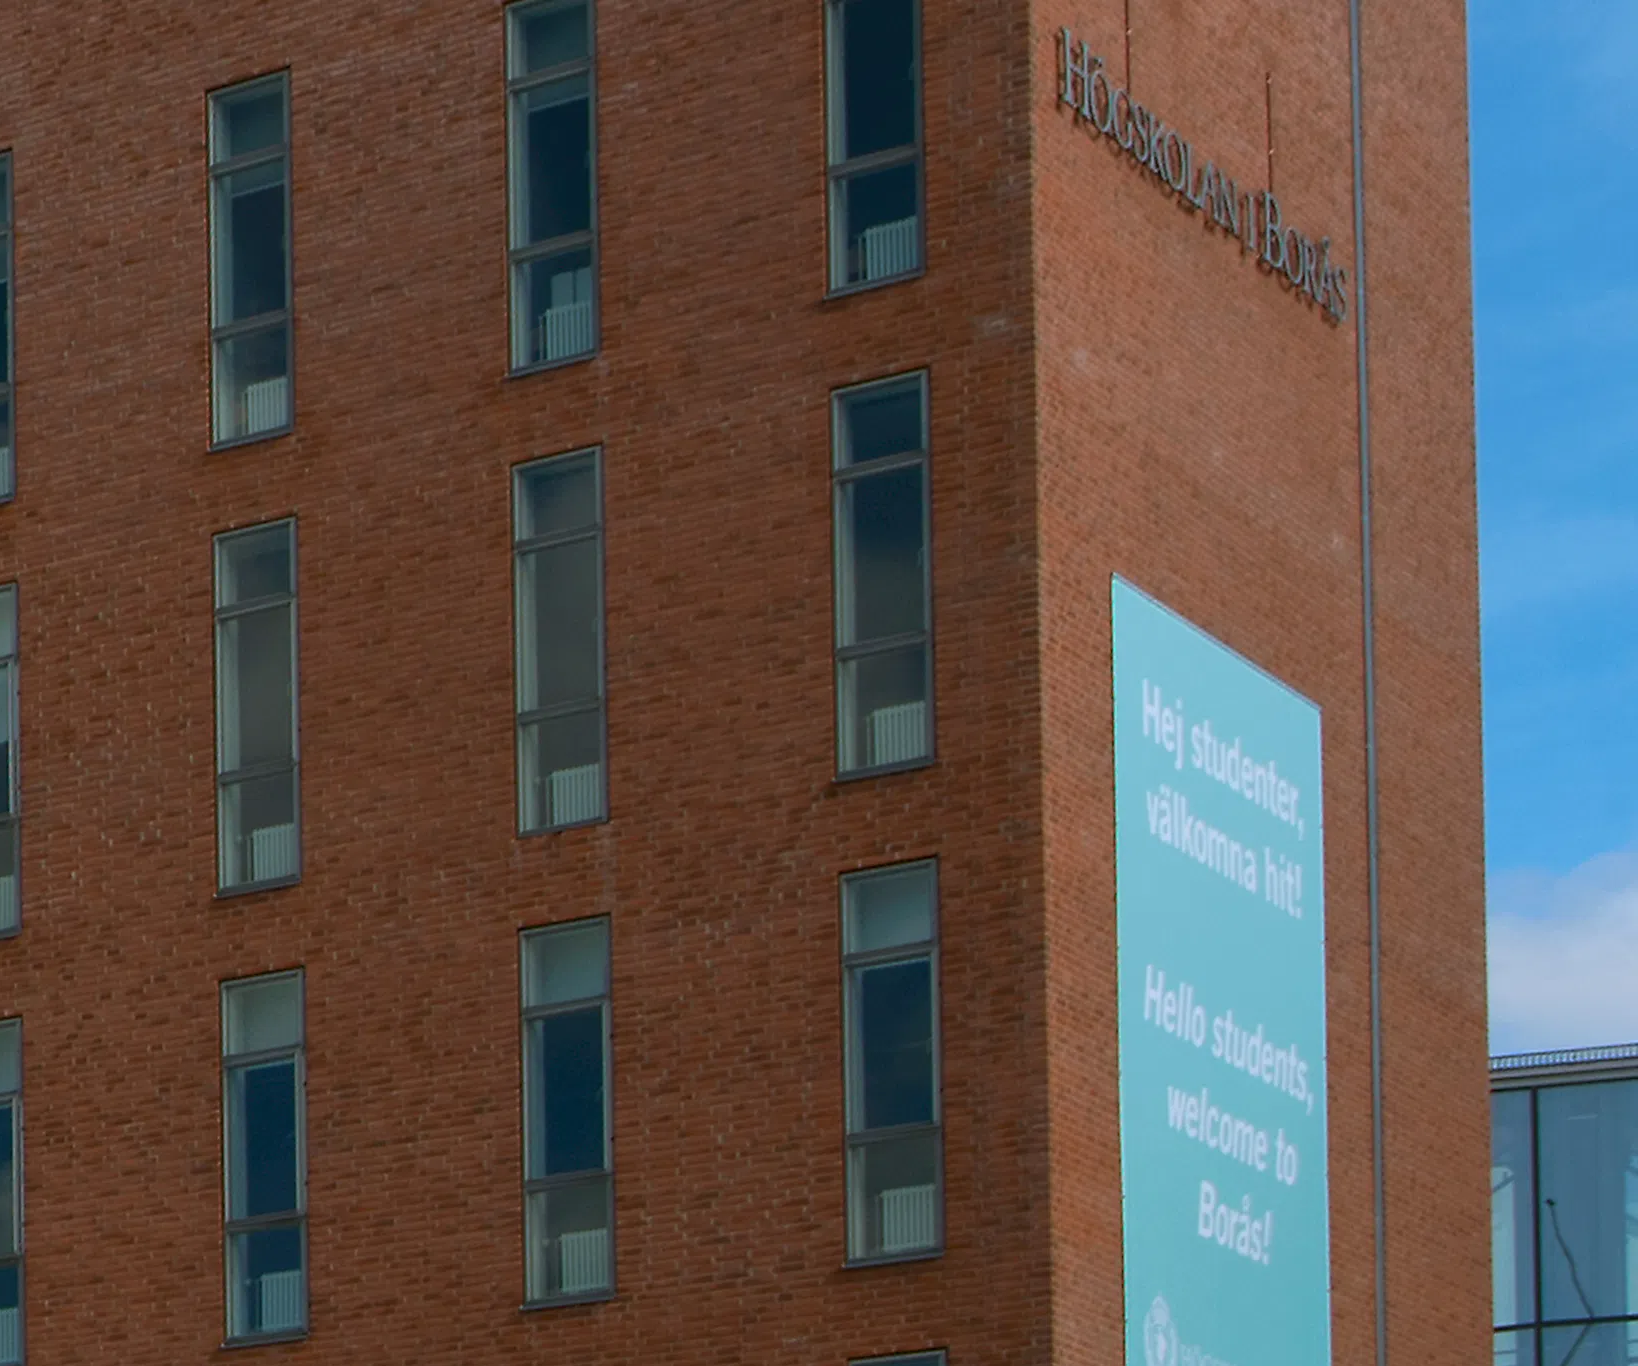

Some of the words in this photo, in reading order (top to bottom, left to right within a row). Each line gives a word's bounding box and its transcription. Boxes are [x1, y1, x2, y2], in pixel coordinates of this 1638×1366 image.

[1058, 25, 1240, 240] HÖGSKOLAN
[1245, 193, 1258, 251] I
[1261, 191, 1349, 324] BORÅS
[1142, 677, 1184, 771] Hej
[1191, 718, 1305, 841] studenter,
[1145, 783, 1257, 894] välkomna
[1264, 846, 1303, 919] hit!
[1143, 963, 1206, 1048] Hello
[1211, 1009, 1315, 1116] students,
[1167, 1084, 1268, 1172] welcome
[1275, 1127, 1298, 1187] to
[1197, 1179, 1274, 1266] Borås!
